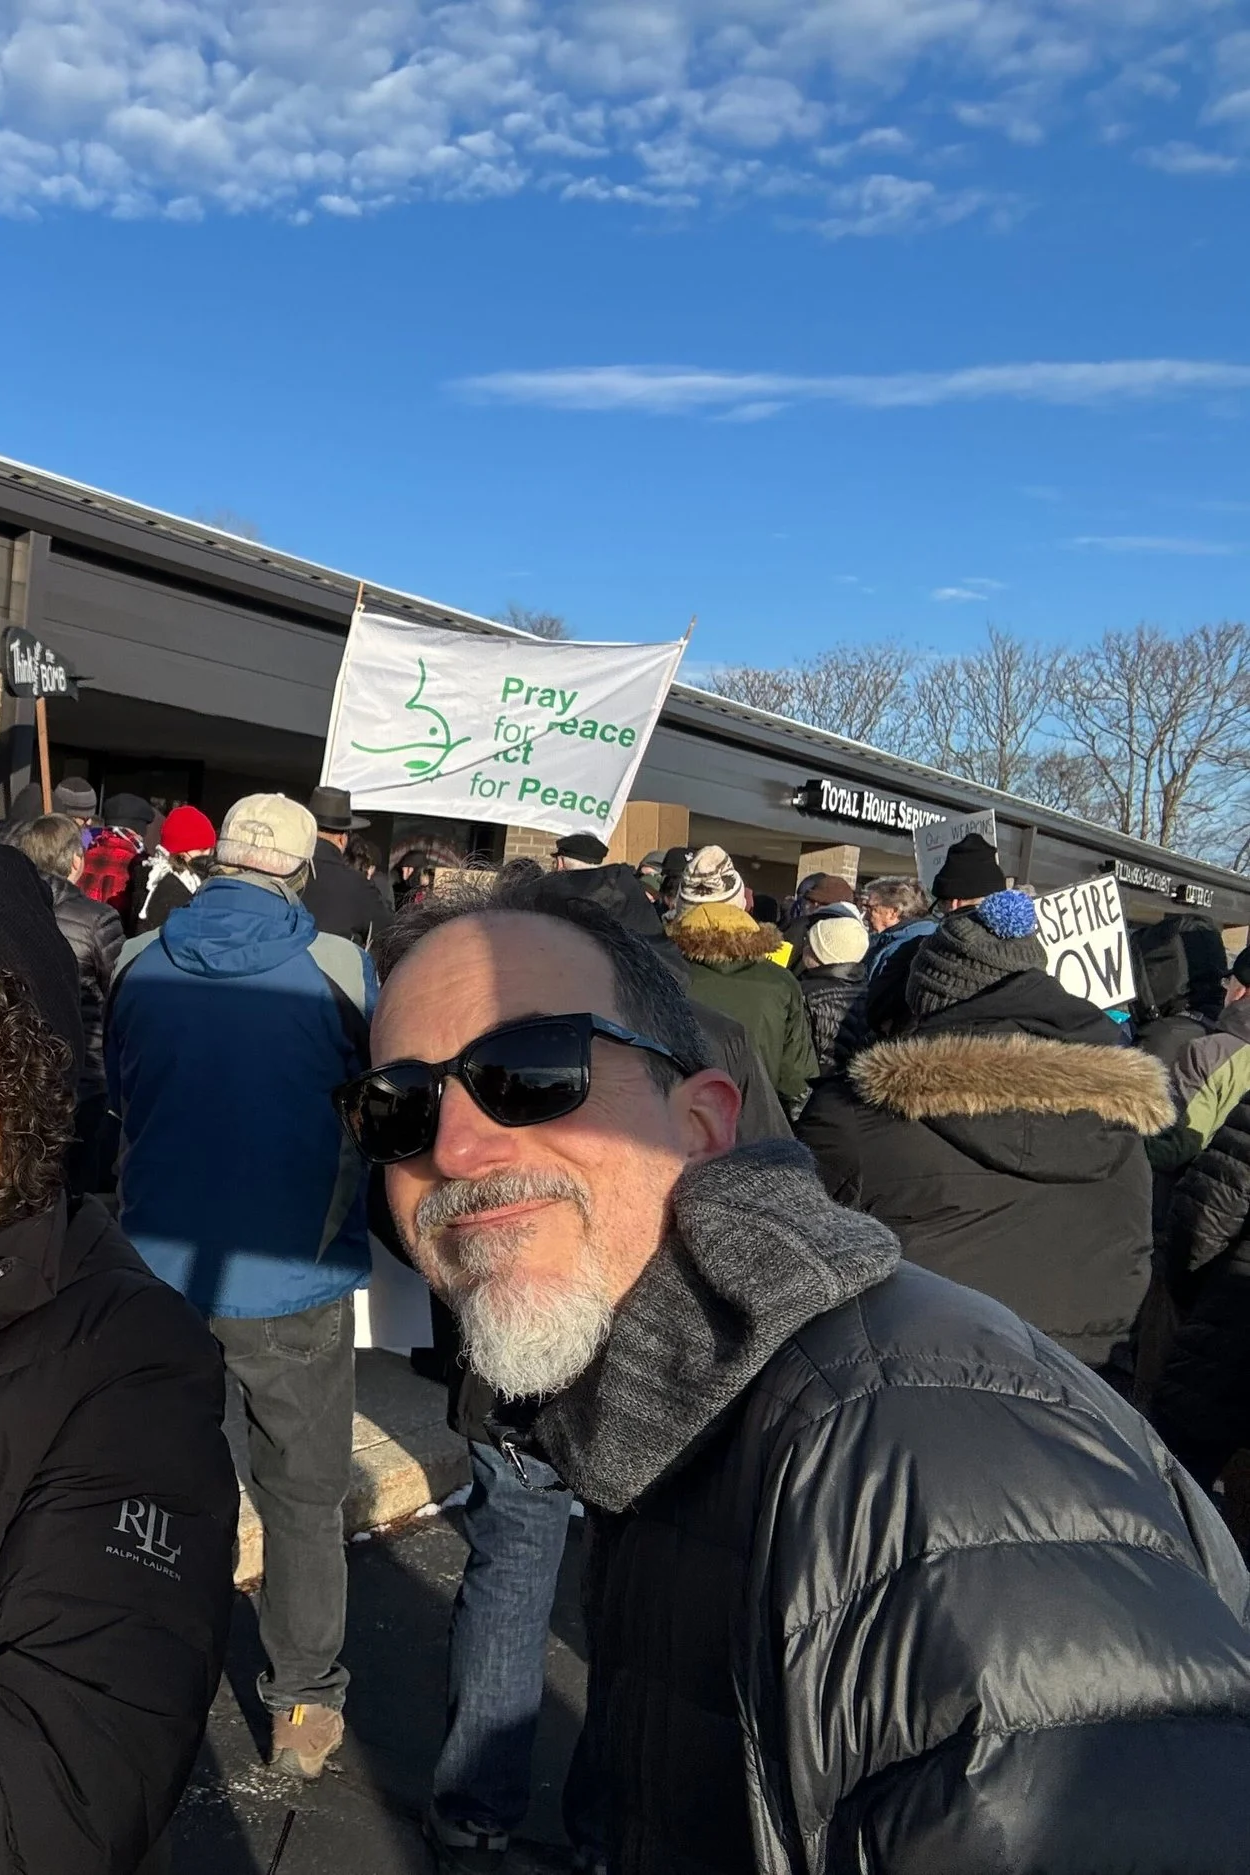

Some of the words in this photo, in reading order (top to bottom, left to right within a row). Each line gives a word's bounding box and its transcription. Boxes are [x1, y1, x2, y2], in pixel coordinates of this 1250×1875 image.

[40, 664, 68, 693] BOMB
[501, 677, 578, 716] Pray
[494, 715, 535, 743] for
[493, 741, 534, 765] ct
[469, 771, 510, 799] for
[518, 777, 611, 820] Peace
[820, 780, 860, 818] TOTAL
[861, 791, 897, 826] HOME
[1037, 880, 1121, 946] SEFIRE
[1055, 932, 1123, 999] OW
[105, 1545, 140, 1562] RALPH
[143, 1558, 181, 1581] LAUREN
